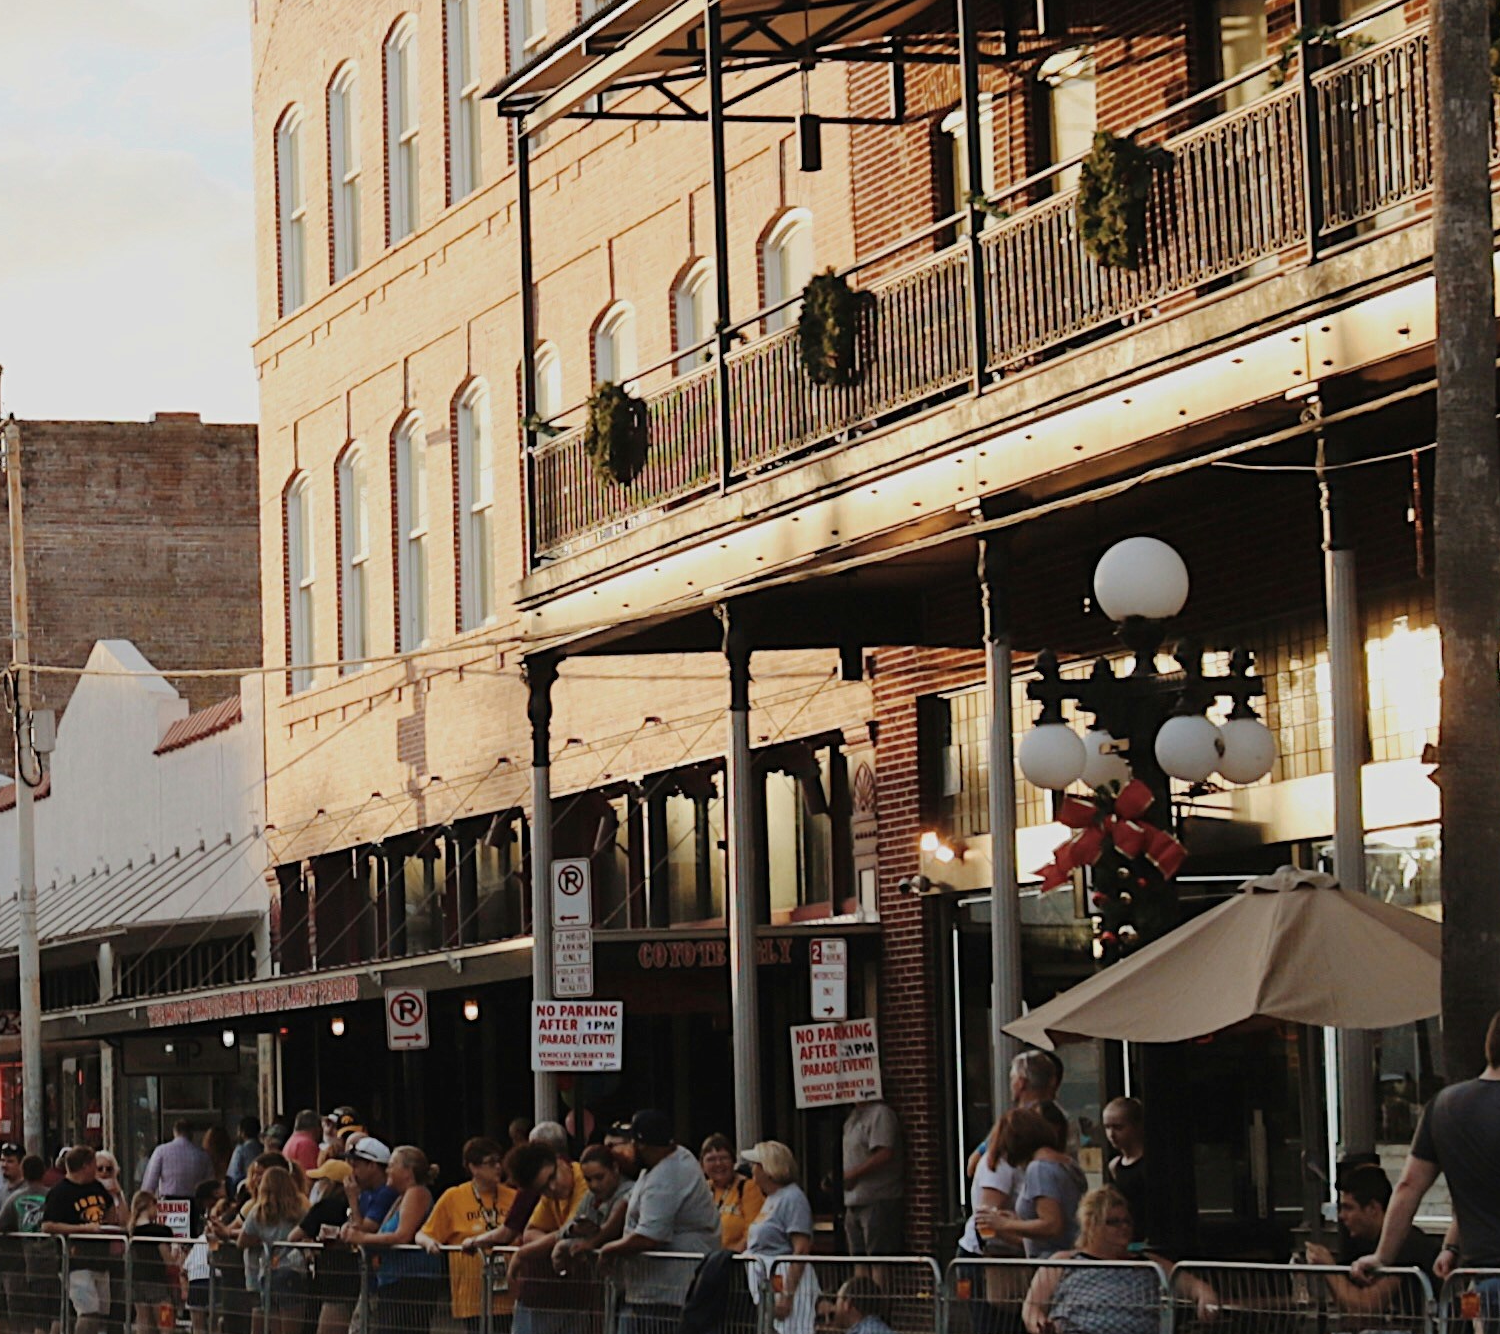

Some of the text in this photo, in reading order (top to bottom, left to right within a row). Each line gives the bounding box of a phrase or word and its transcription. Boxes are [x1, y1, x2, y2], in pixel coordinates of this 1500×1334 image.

[638, 941, 728, 969] COYOTE
[812, 944, 821, 961] 2
[536, 1005, 618, 1018] NO PARKING
[539, 1019, 615, 1031] AFTER 1PM
[795, 1022, 873, 1044] NO PARKING
[538, 1051, 616, 1060] VEHICLES SUBJECT TO
[800, 1042, 838, 1061] AFTER
[540, 1059, 570, 1068] TOWING
[571, 1059, 593, 1068] AFTER
[802, 1077, 875, 1094] VEHICLES SUBJECT TO
[805, 1092, 833, 1103] TOWING
[835, 1089, 856, 1100] AFTER
